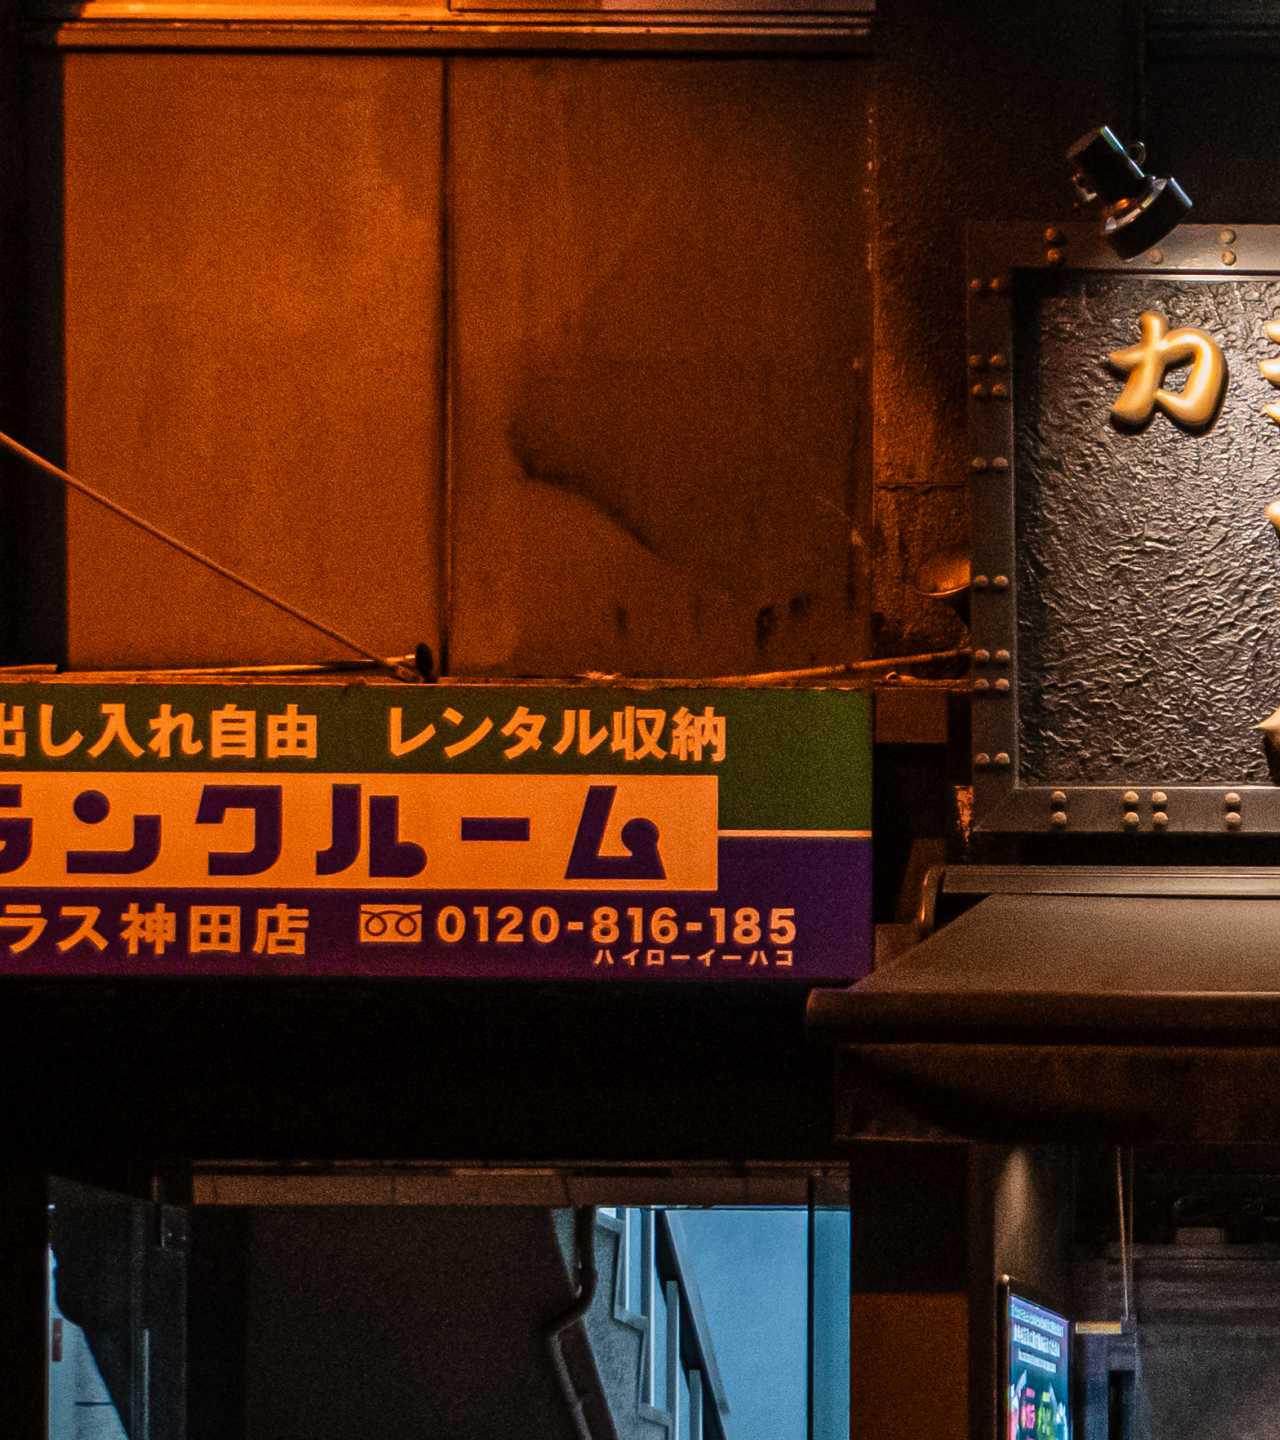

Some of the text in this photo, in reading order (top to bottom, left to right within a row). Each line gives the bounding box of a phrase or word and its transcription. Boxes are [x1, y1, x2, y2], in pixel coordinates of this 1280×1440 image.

[389, 705, 727, 762] レンタル収納
[437, 905, 797, 945] 0120-816-185
[594, 948, 793, 967] ハイローイーハコ
